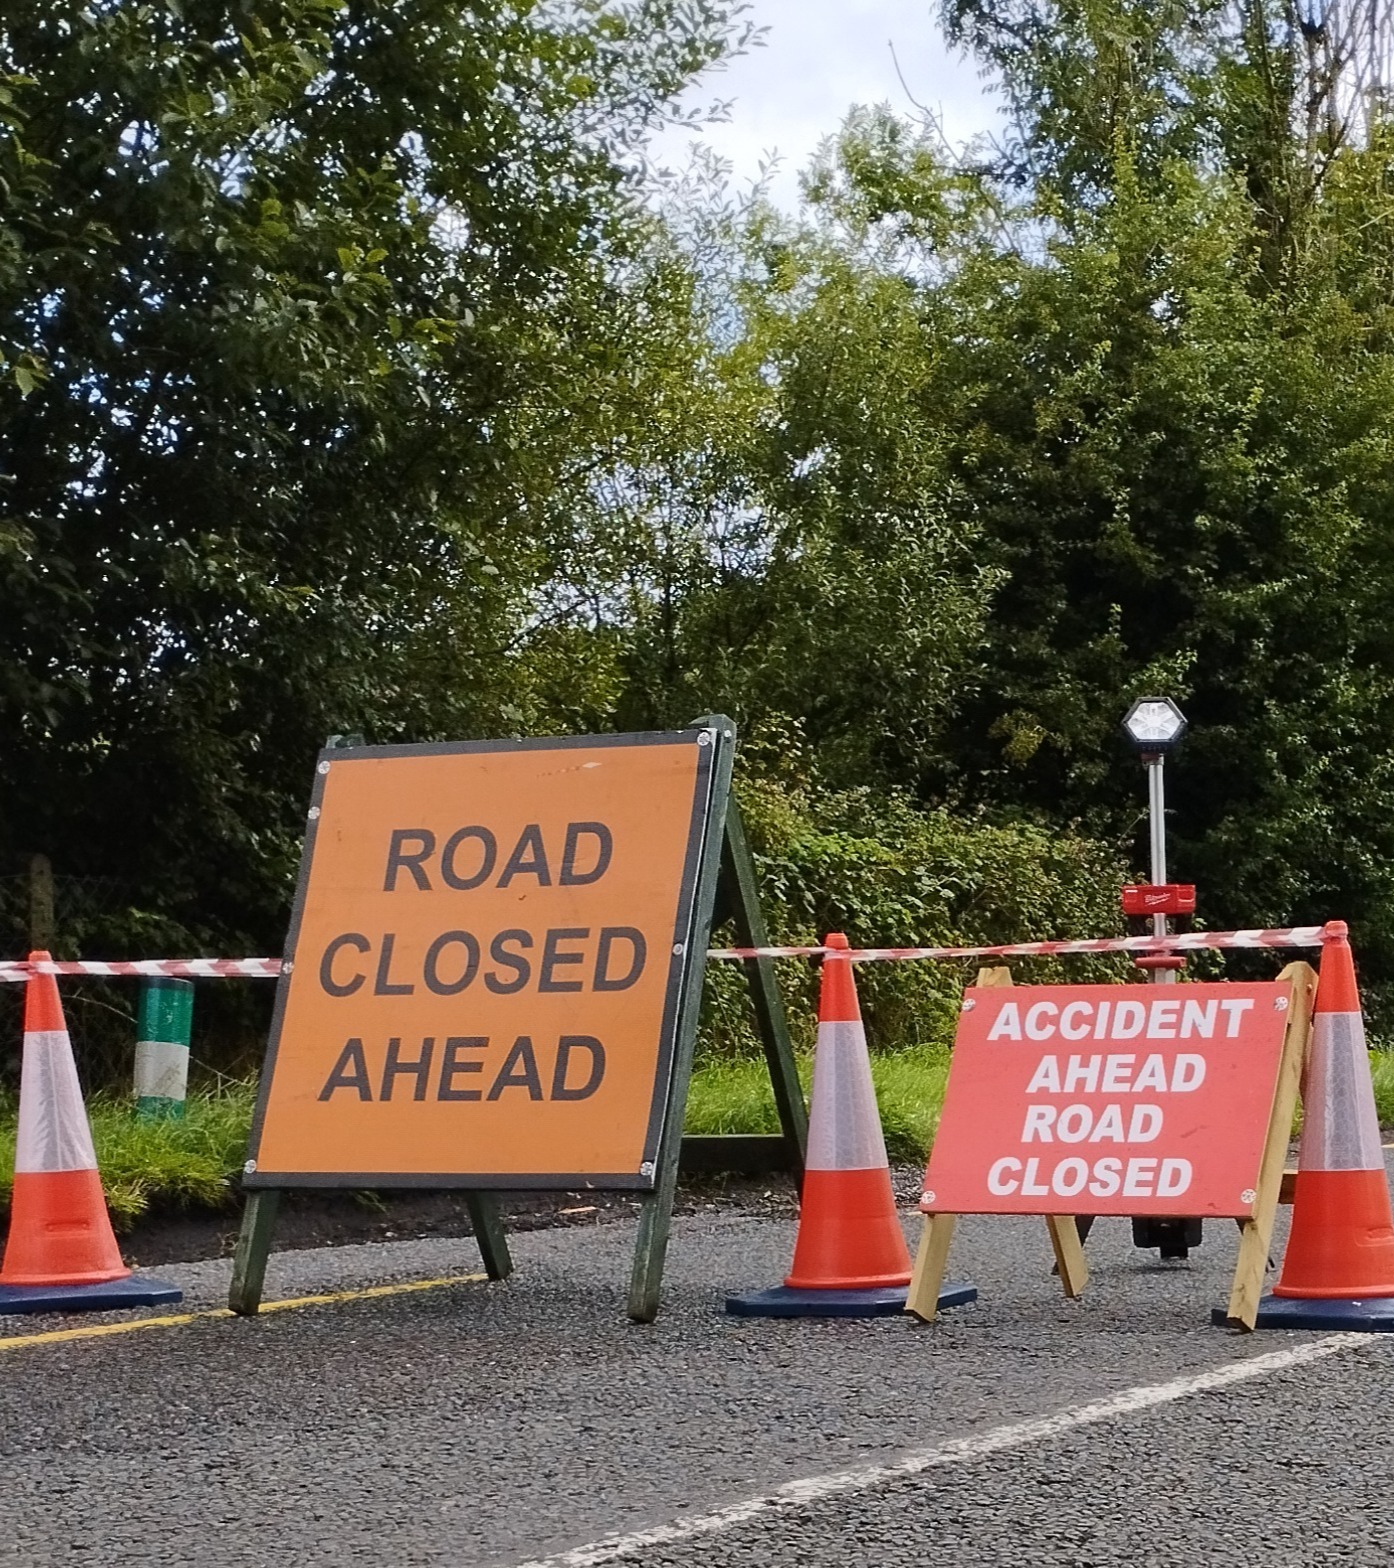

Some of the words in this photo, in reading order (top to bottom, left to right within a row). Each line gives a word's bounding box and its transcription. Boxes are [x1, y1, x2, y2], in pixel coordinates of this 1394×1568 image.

[382, 822, 614, 892] ROAD
[318, 926, 647, 997] CLOSED
[987, 998, 1255, 1041] ACCIDENT
[318, 1035, 607, 1102] AHEAD
[1026, 1053, 1206, 1093] AHEAD
[1021, 1104, 1163, 1144] ROAD
[987, 1156, 1193, 1198] CLOSED
